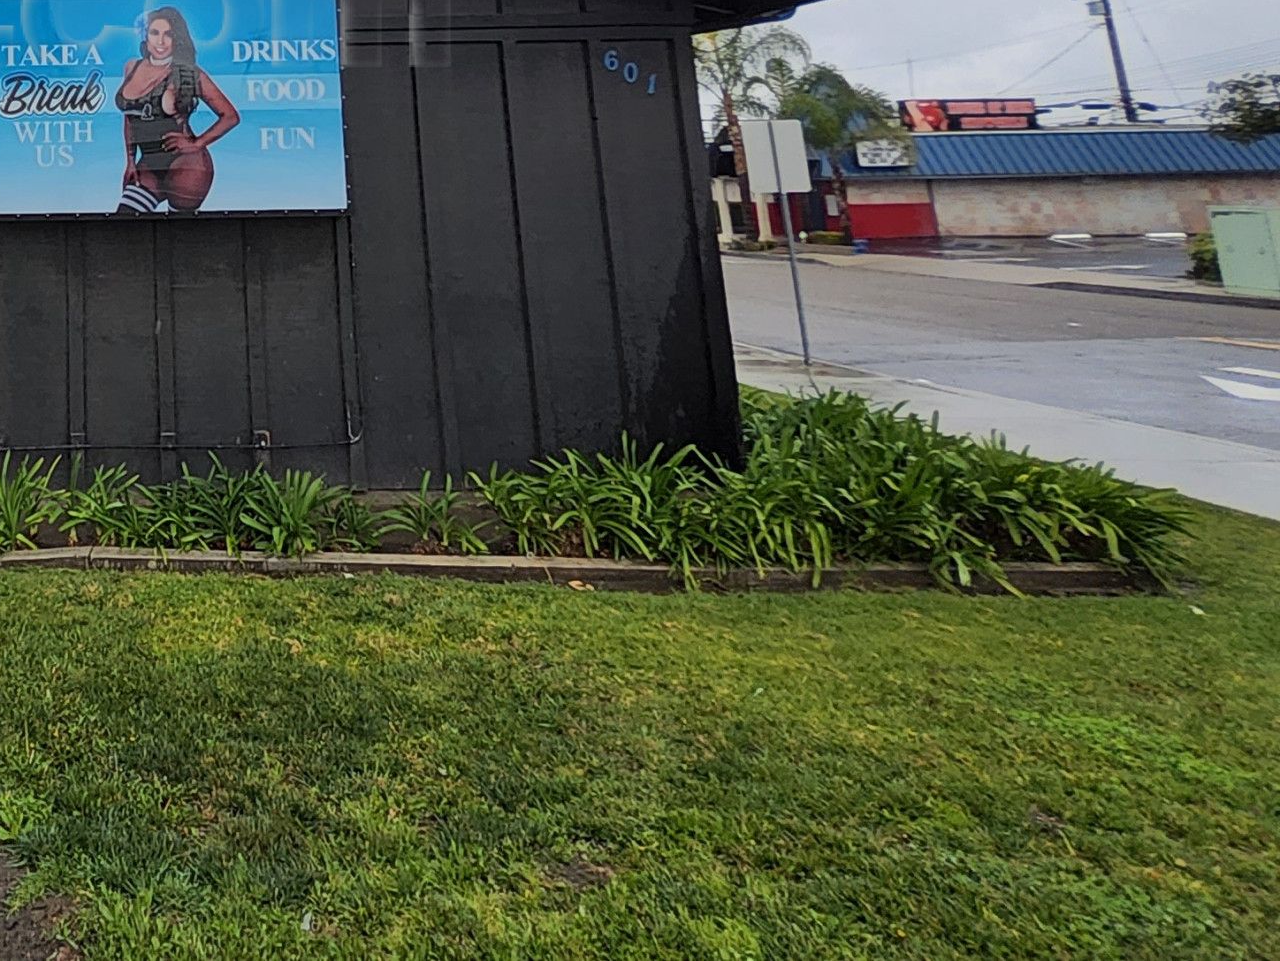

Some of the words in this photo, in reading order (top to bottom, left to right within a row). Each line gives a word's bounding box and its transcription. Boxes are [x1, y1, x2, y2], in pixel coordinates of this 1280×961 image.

[1, 43, 79, 67] TAKE
[83, 43, 105, 66] A
[231, 38, 337, 63] DRINKS
[603, 49, 657, 95] 601
[0, 71, 103, 117] Break
[246, 77, 326, 102] FOOD
[13, 120, 95, 144] WITH
[259, 126, 316, 151] FUN
[36, 144, 74, 167] US
